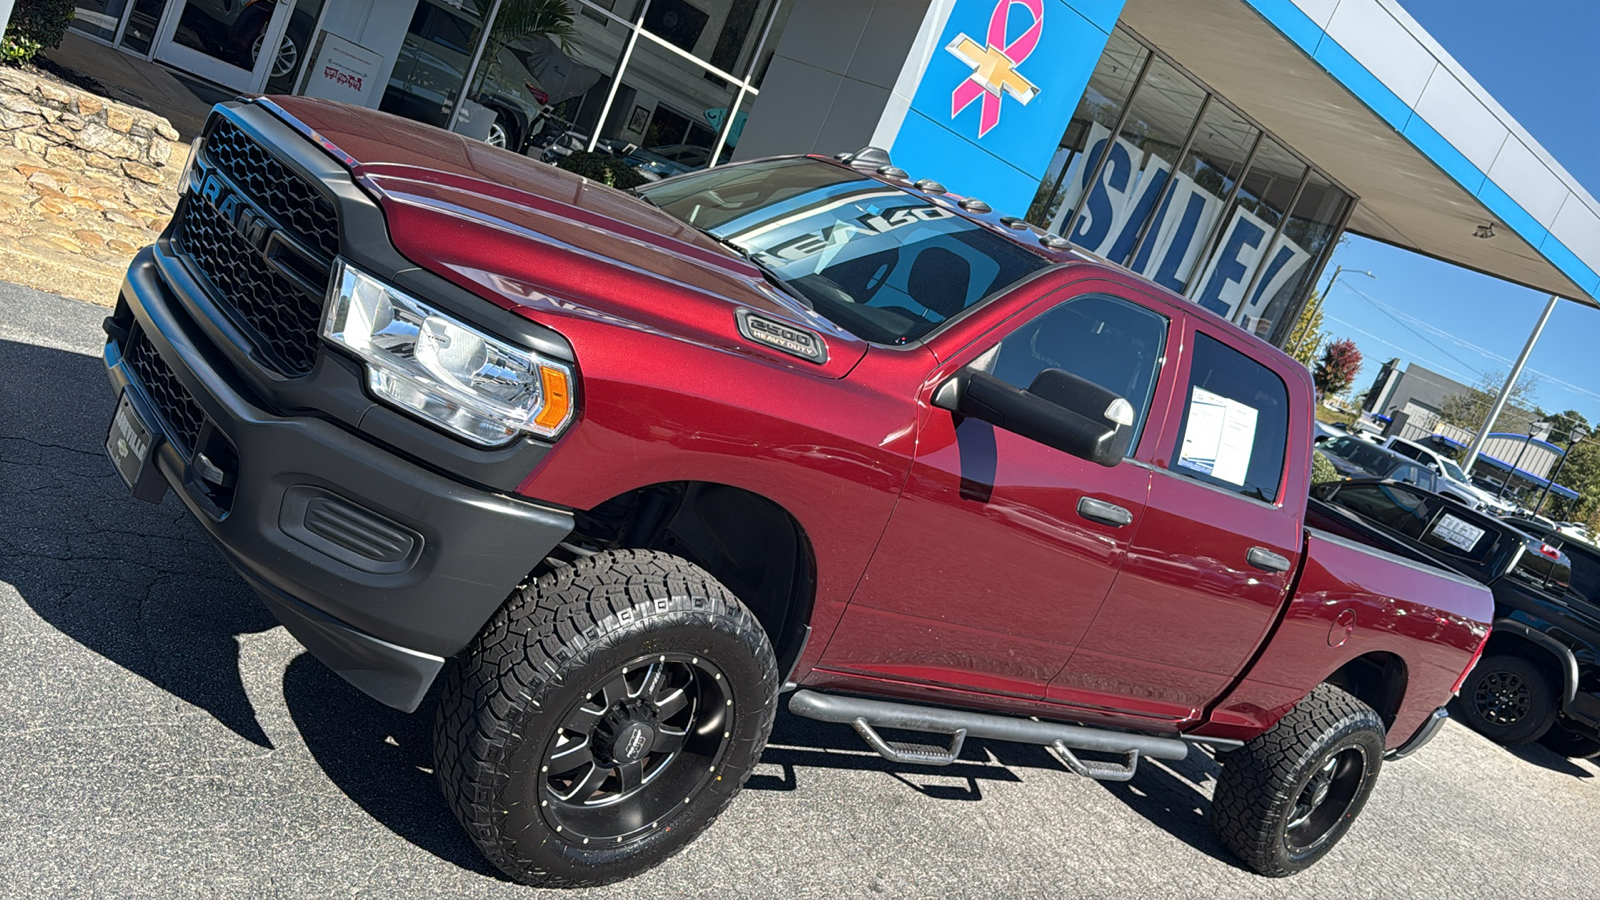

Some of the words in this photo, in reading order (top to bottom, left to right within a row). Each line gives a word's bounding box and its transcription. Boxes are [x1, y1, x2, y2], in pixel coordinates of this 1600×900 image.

[203, 174, 268, 249] RAM
[1059, 138, 1296, 328] SALE!
[750, 319, 811, 347] 2500
[753, 331, 786, 346] HEAVY
[786, 342, 813, 354] DUTY
